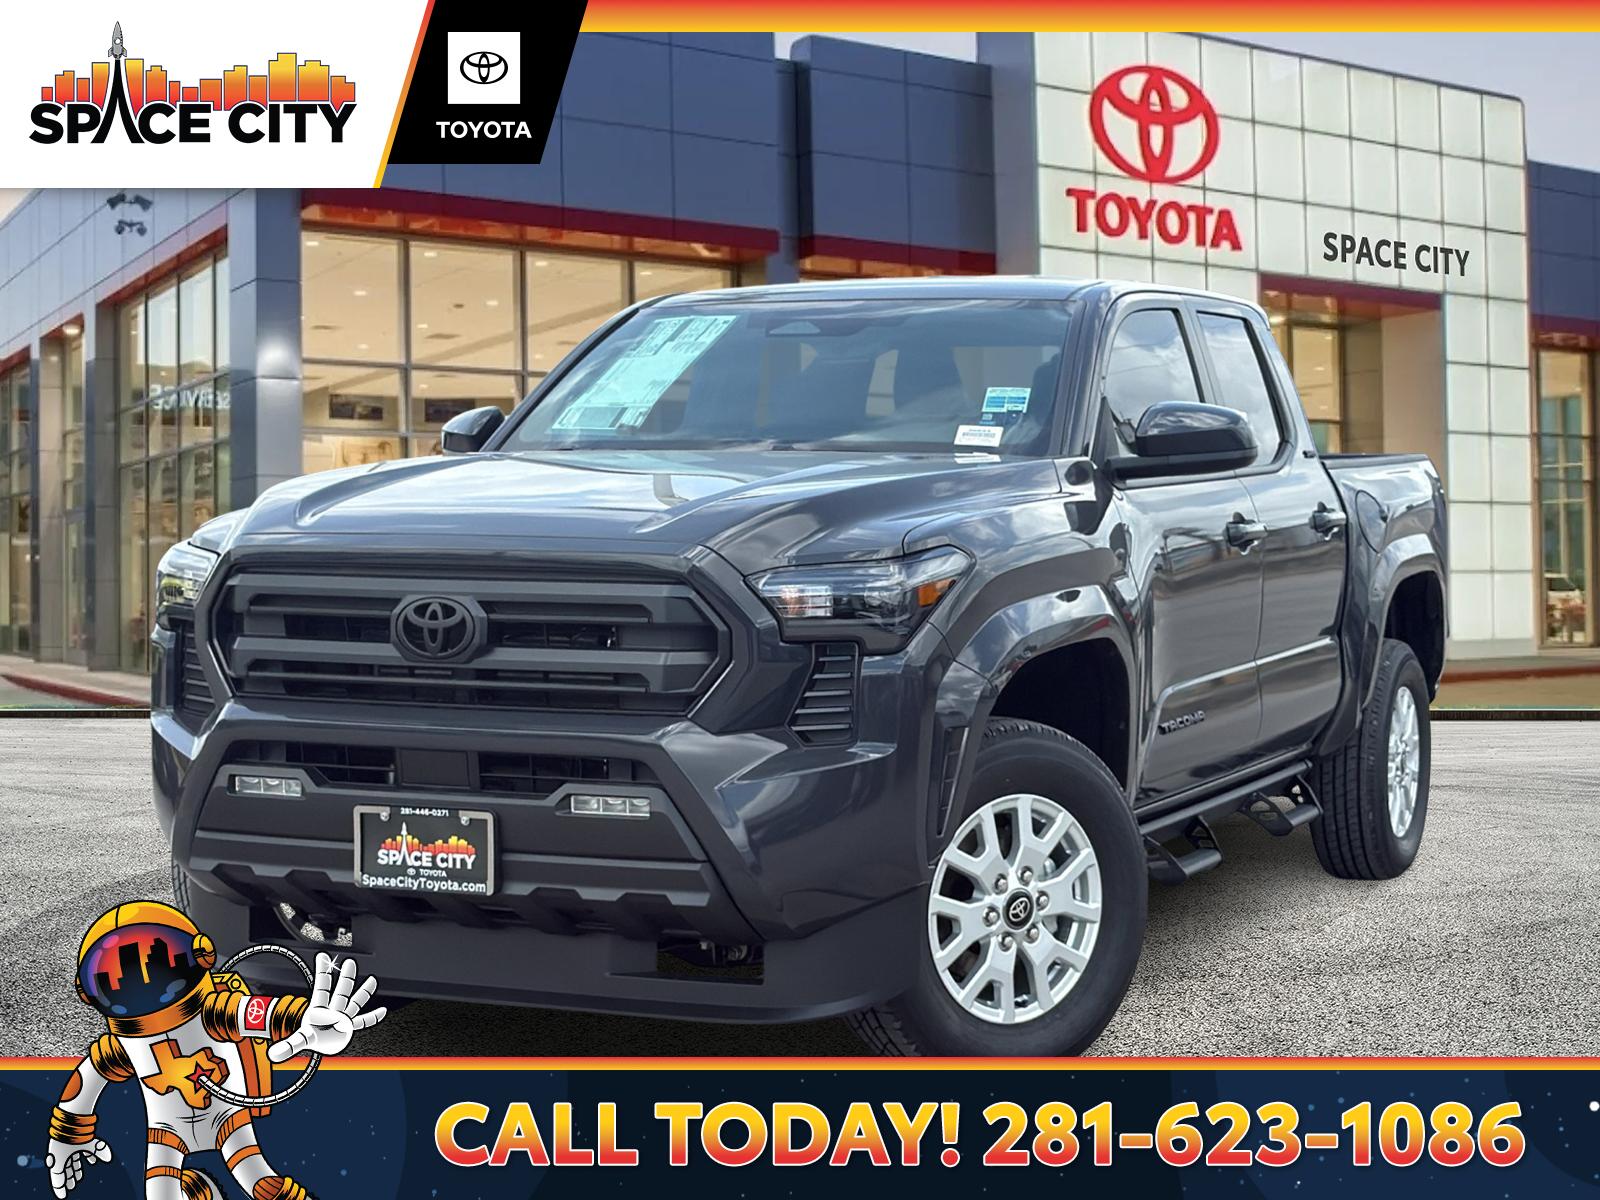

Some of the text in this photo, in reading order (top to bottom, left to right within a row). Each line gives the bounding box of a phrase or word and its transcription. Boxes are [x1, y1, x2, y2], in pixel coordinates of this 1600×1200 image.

[1066, 187, 1242, 252] TOYOTA
[1323, 232, 1470, 277] SPACE CITY
[377, 842, 476, 869] SPACE CITY
[362, 873, 486, 892] SpaceCityToyota.com
[419, 868, 447, 877] TOYOTA
